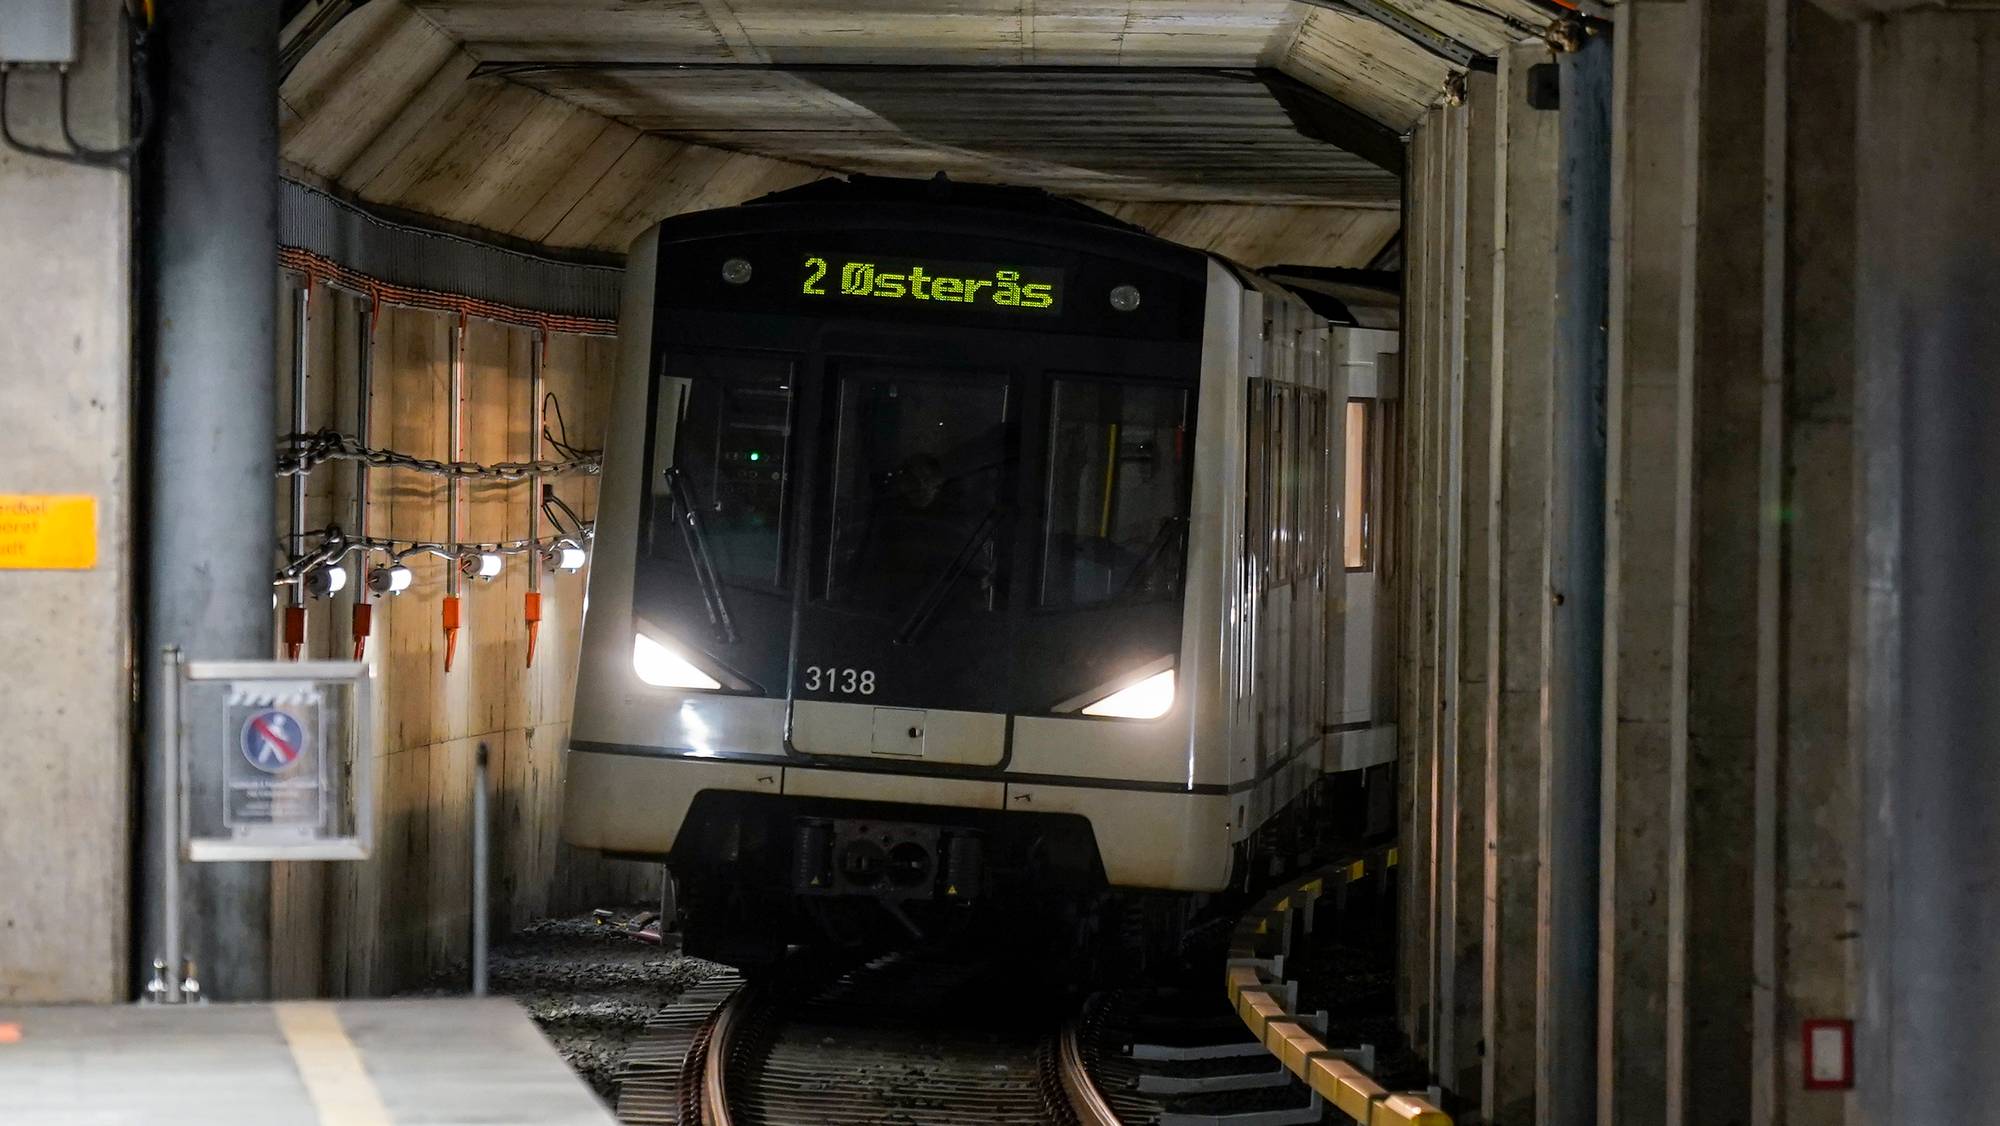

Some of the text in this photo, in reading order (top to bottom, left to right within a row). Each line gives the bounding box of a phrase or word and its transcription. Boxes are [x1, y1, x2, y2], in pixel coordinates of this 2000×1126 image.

[802, 257, 1053, 308] 2 Østerås
[805, 665, 876, 695] 3138
